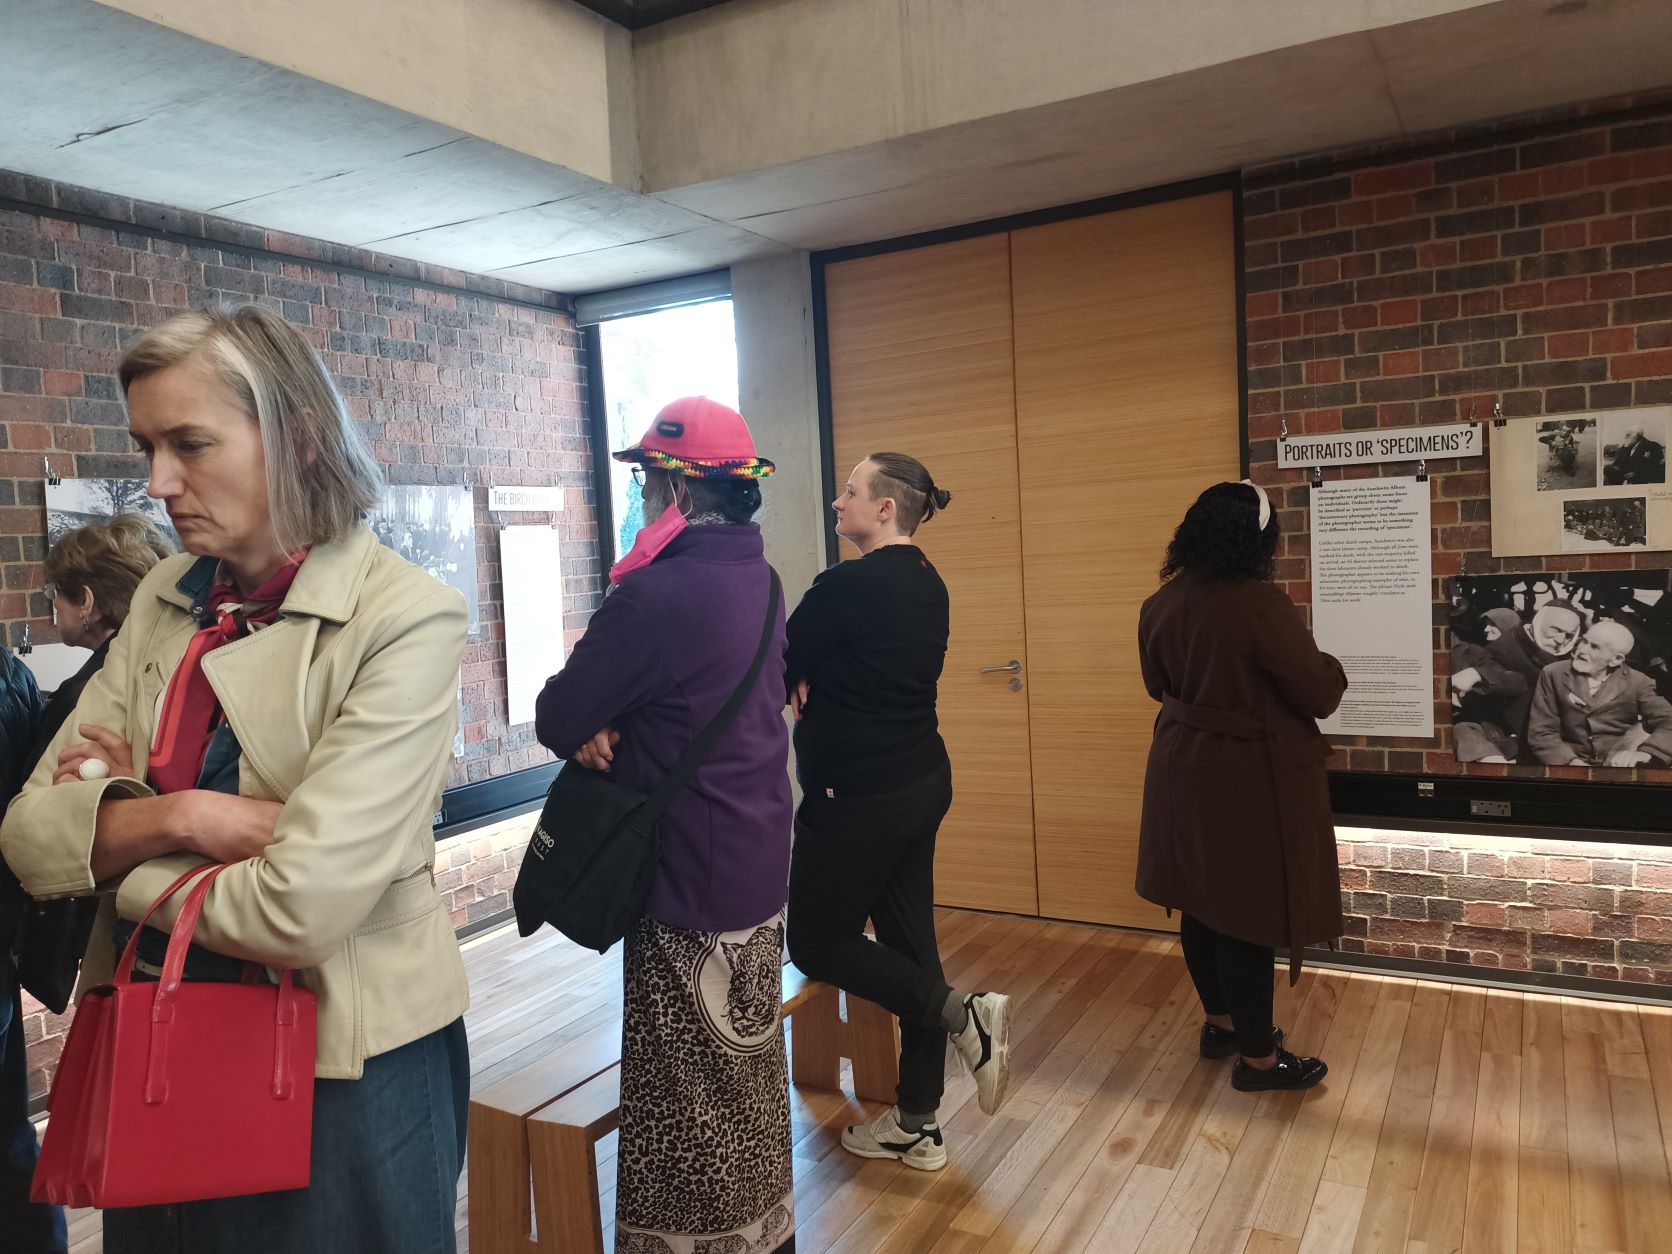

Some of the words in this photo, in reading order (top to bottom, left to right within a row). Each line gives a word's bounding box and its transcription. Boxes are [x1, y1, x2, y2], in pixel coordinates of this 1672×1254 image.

[1284, 441, 1353, 462] PORTRAITS
[1356, 440, 1374, 457] OR
[1376, 430, 1474, 456] 'SPECIMENS'?
[493, 490, 508, 505] THE
